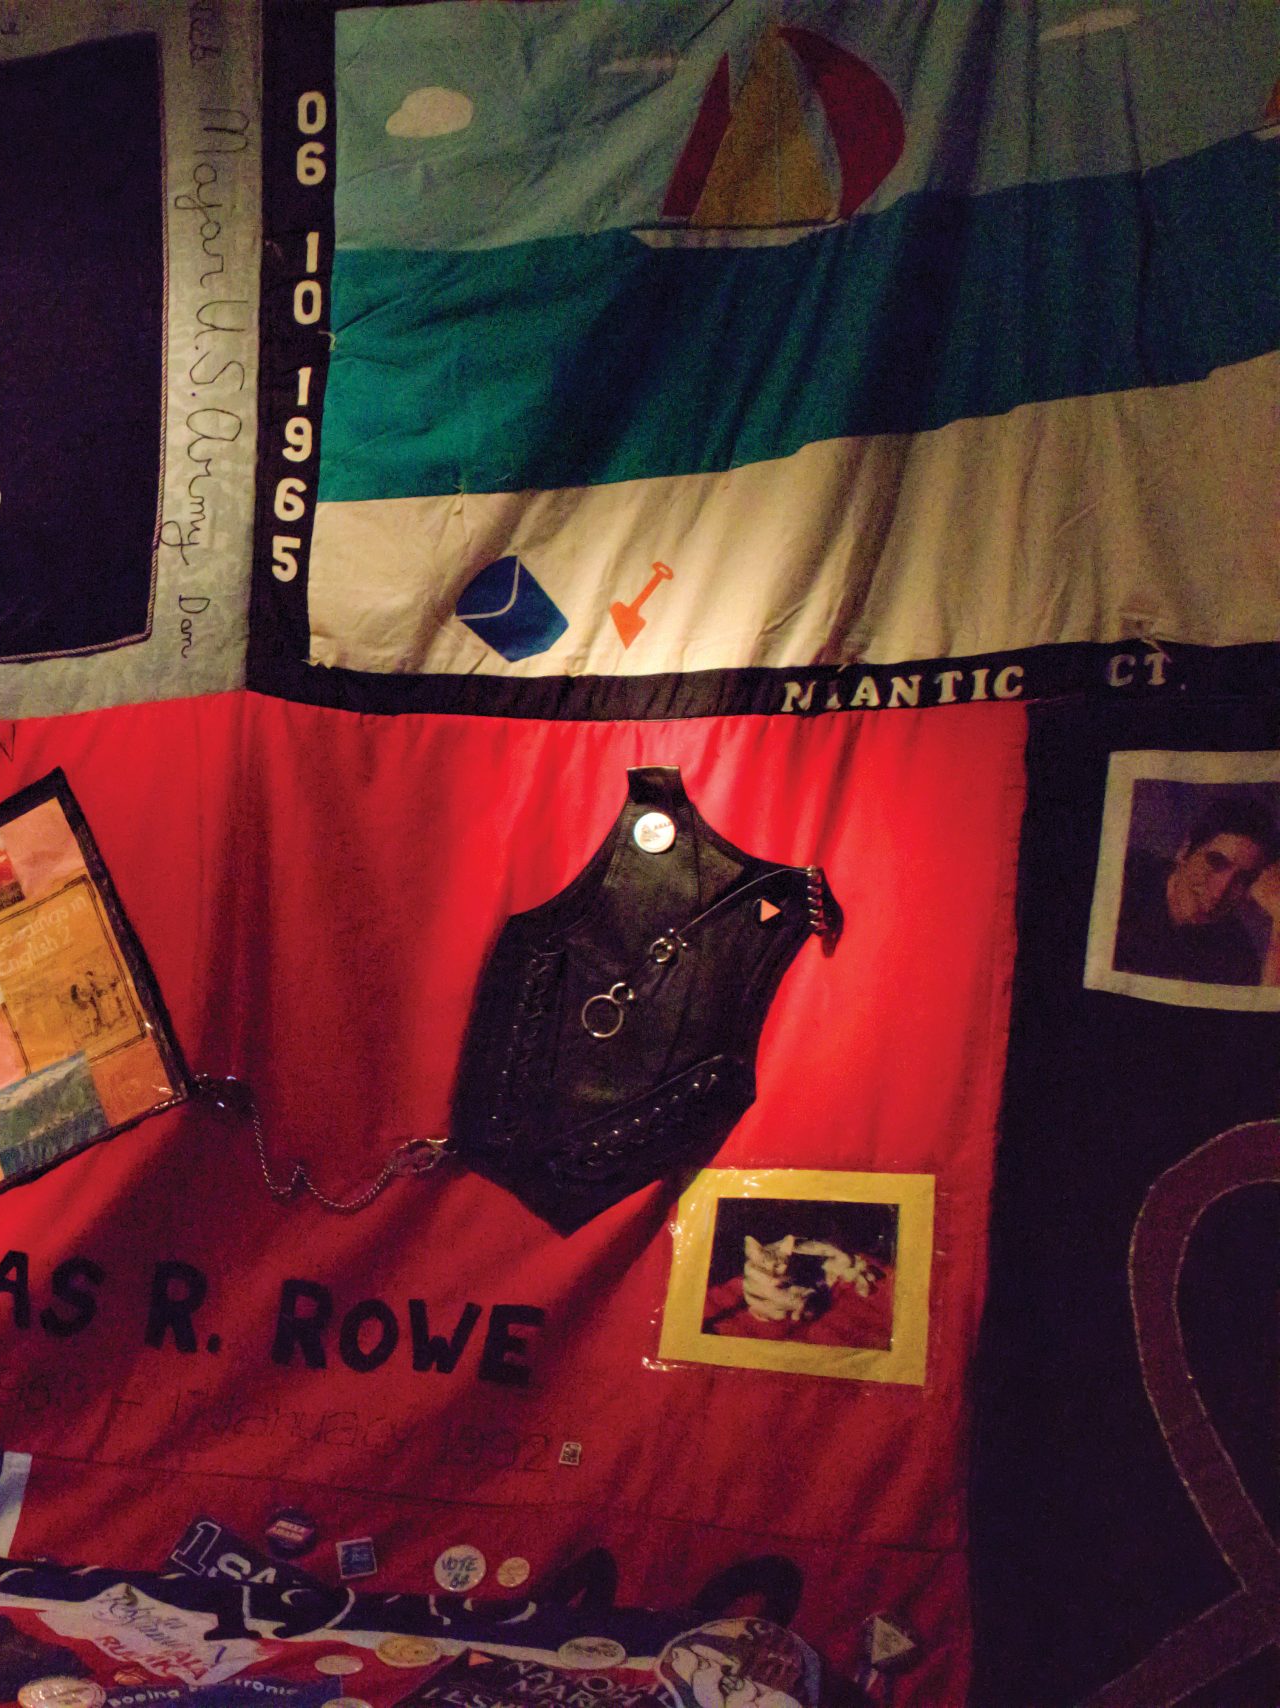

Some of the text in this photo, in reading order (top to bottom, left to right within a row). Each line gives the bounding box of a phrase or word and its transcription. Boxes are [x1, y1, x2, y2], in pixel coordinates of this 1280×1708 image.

[272, 91, 327, 583] 06 10 1965
[159, 408, 242, 566] Army
[143, 1261, 222, 1355] R.
[271, 1278, 548, 1387] ROWE
[440, 1554, 479, 1574] VOTE
